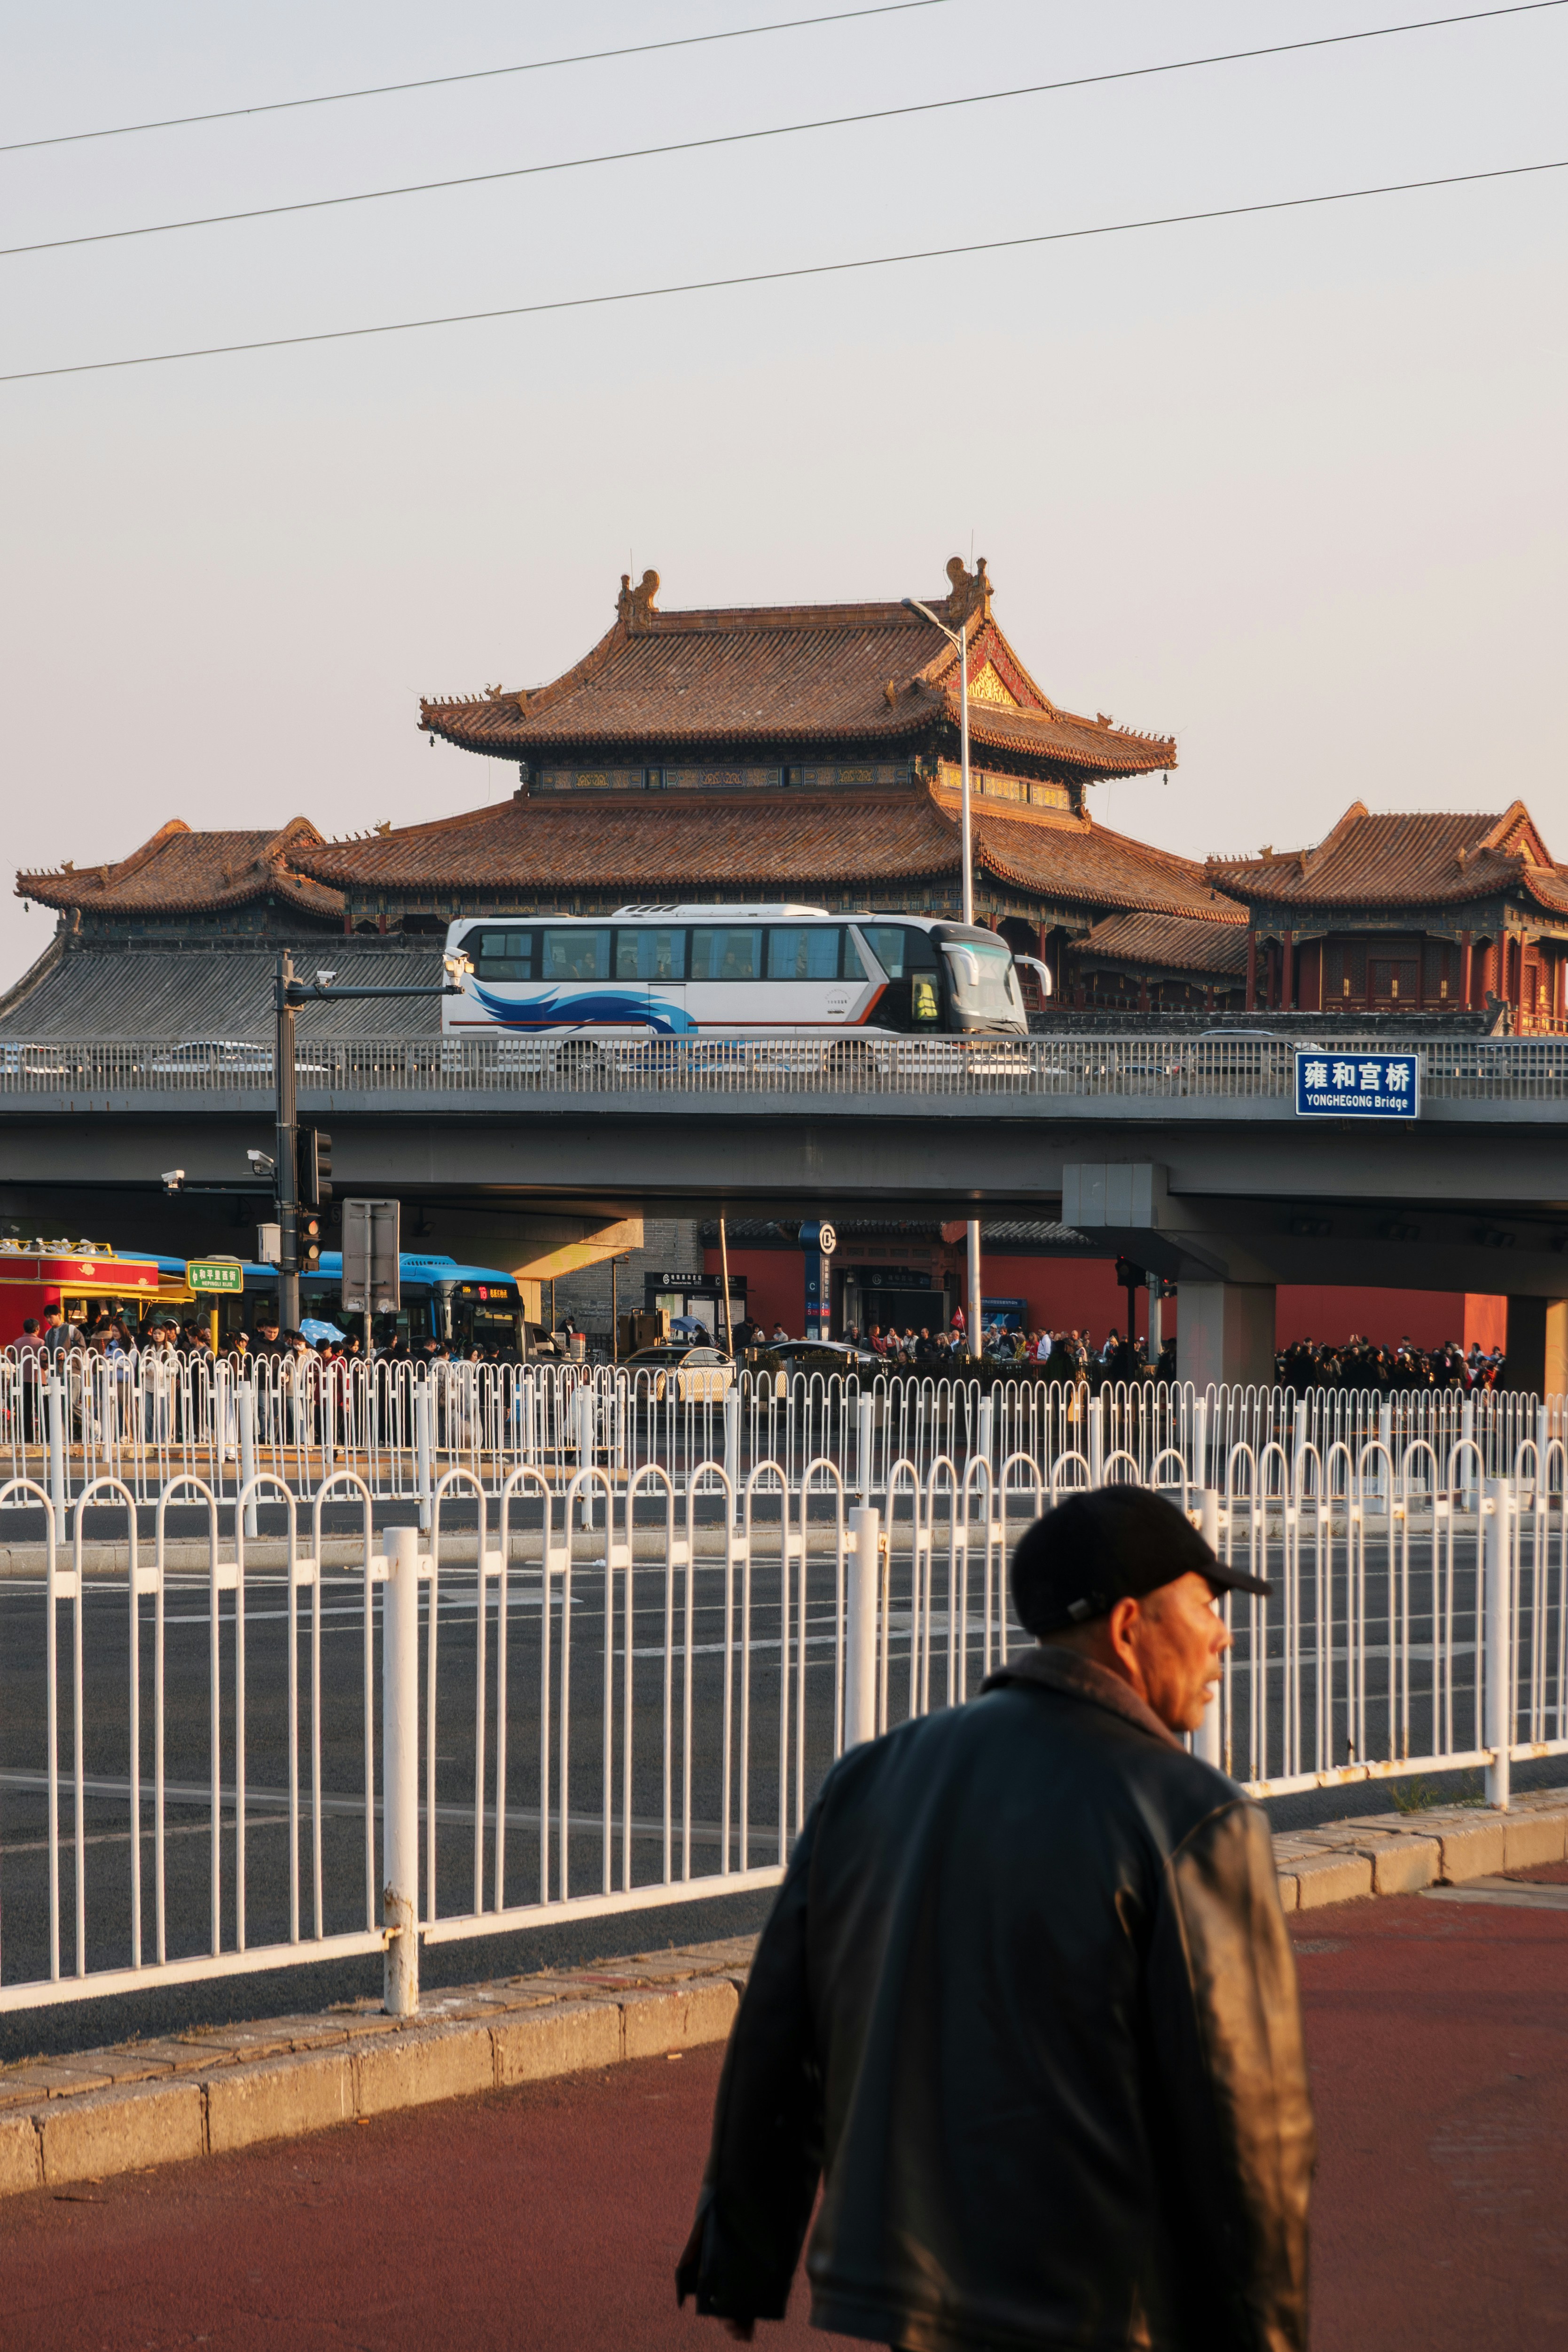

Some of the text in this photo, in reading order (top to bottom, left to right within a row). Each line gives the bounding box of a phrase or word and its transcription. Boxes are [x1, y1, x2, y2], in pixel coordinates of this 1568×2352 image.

[1304, 1061, 1410, 1091] 雍和宫桥
[1306, 1094, 1408, 1111] YONGHEGONG Bridge
[199, 1269, 235, 1281] 和平里西街
